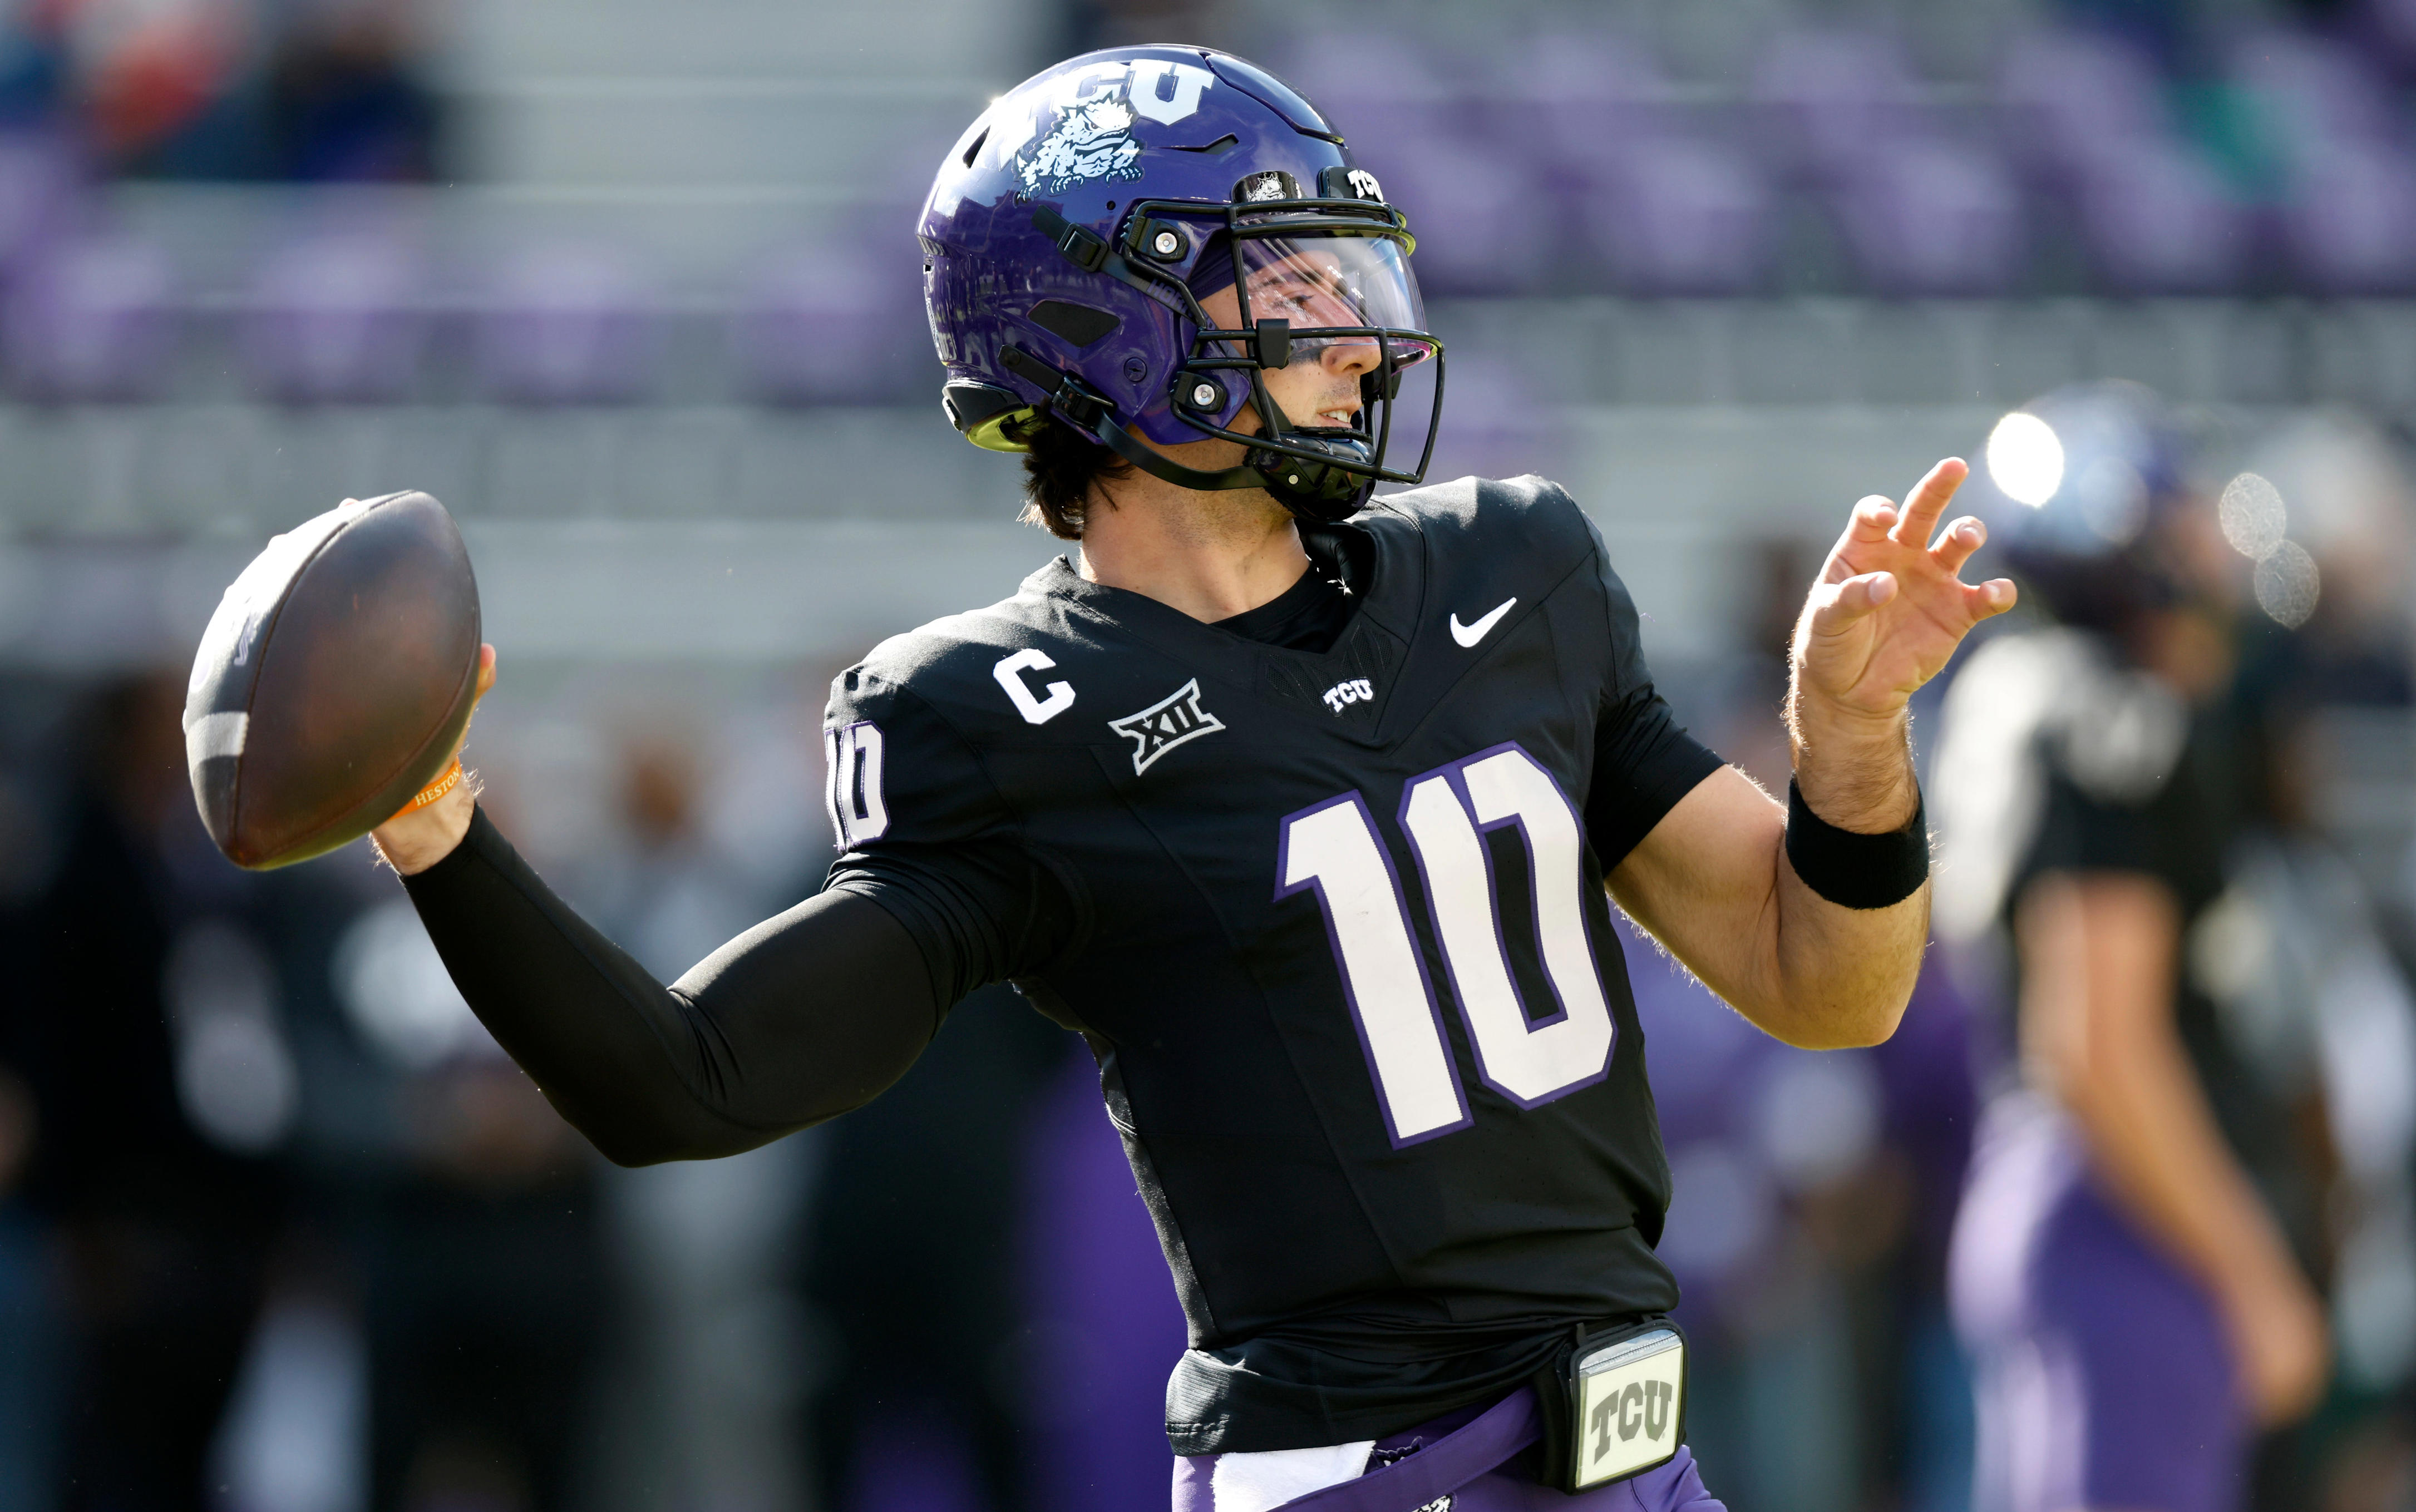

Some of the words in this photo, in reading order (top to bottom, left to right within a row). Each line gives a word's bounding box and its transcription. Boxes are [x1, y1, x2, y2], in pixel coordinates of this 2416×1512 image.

[993, 648, 1076, 725] C
[1113, 681, 1220, 772] XII
[1323, 679, 1373, 713] TCU
[415, 766, 461, 806] HESTON
[1272, 740, 1618, 1152] 10
[1590, 1380, 1673, 1466] TCU
